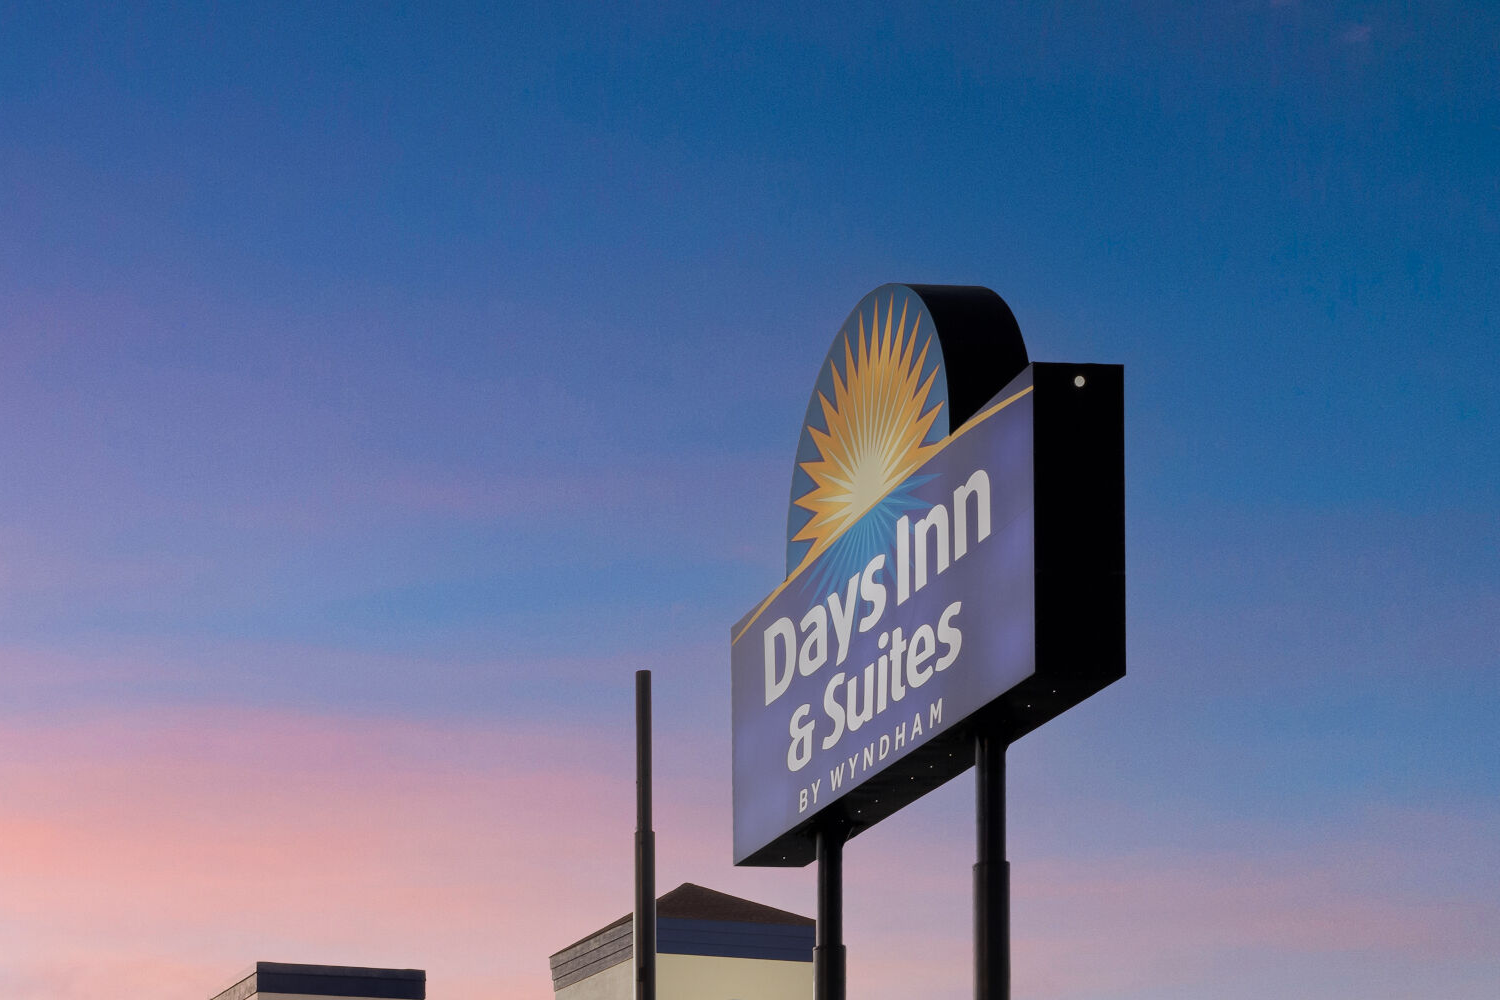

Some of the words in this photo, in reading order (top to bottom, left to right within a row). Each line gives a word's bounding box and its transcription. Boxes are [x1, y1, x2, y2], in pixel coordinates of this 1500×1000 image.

[764, 553, 887, 706] Days
[896, 469, 991, 606] Inn
[787, 703, 815, 772] &
[822, 601, 963, 751] Suites
[798, 778, 821, 813] BY
[830, 698, 943, 794] WYNDHAM
